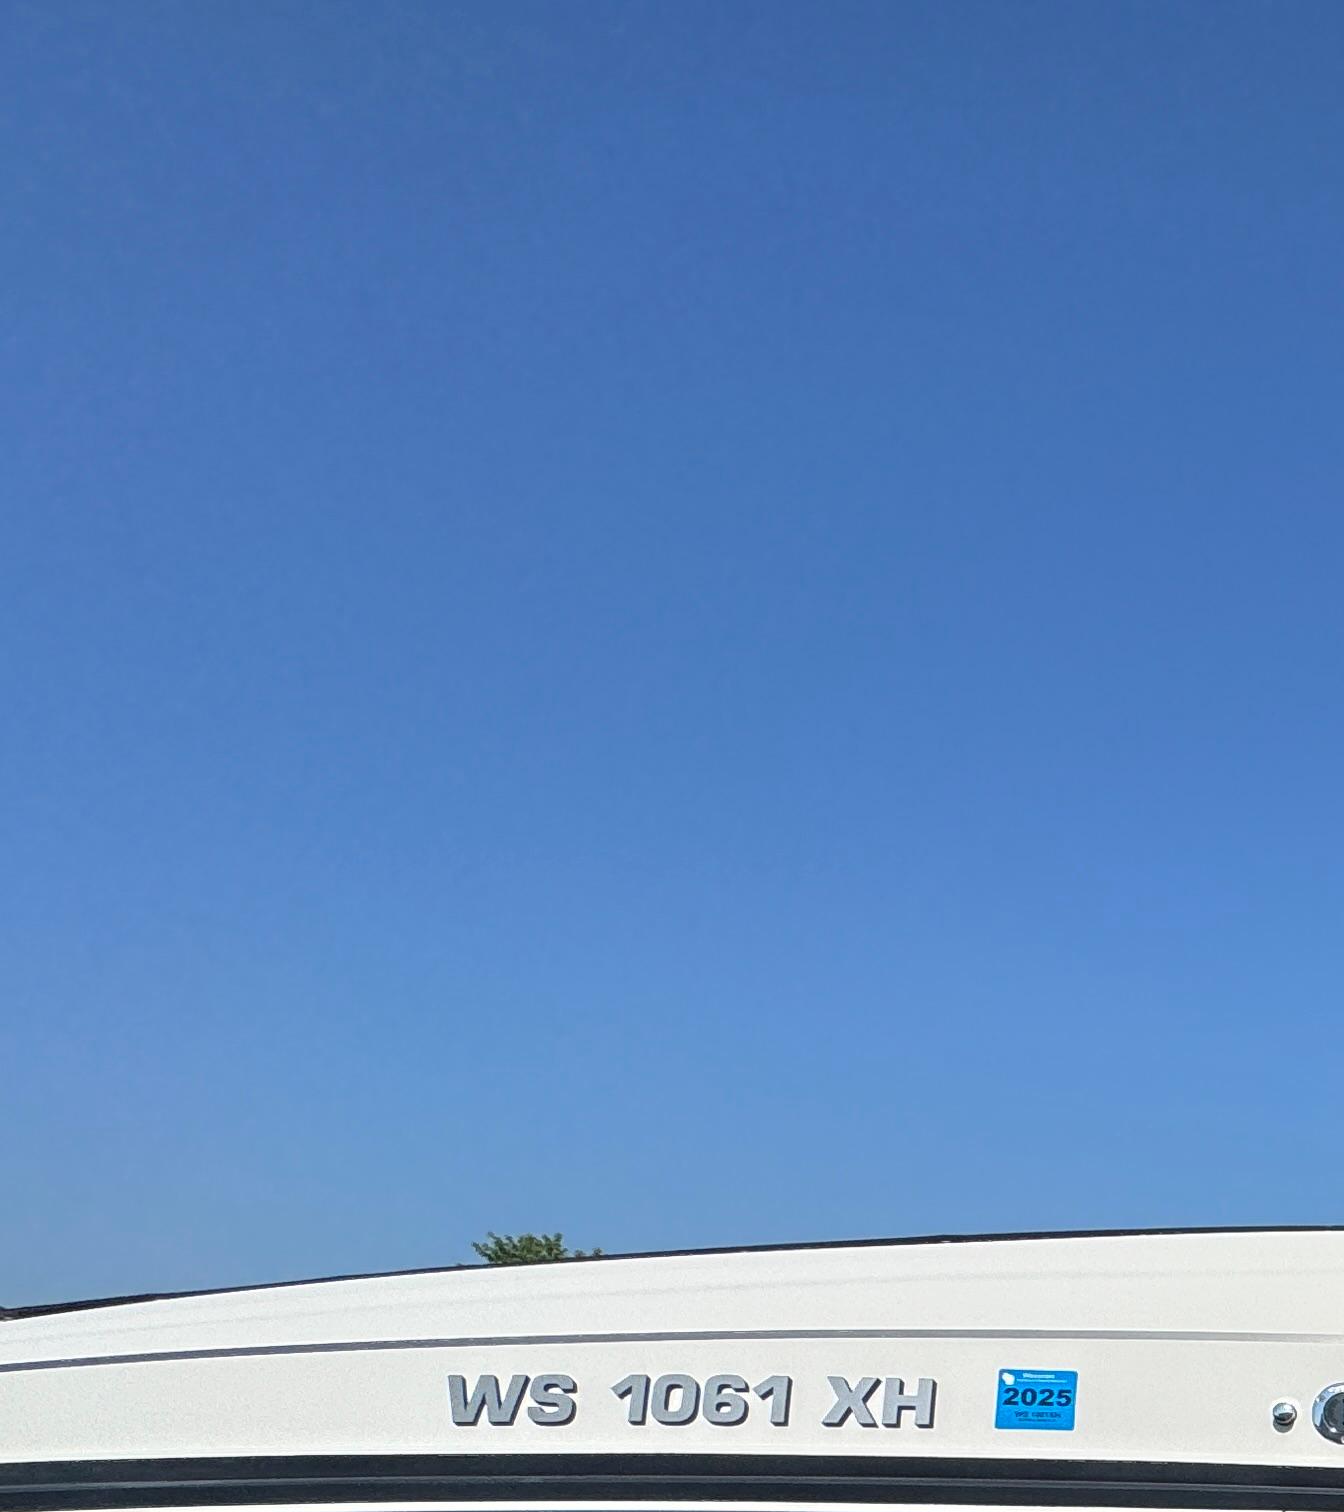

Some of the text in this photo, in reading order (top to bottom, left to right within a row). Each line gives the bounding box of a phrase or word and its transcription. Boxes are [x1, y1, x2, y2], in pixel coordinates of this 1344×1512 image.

[447, 1374, 938, 1428] WS 1061 XH
[1002, 1387, 1072, 1407] 2025
